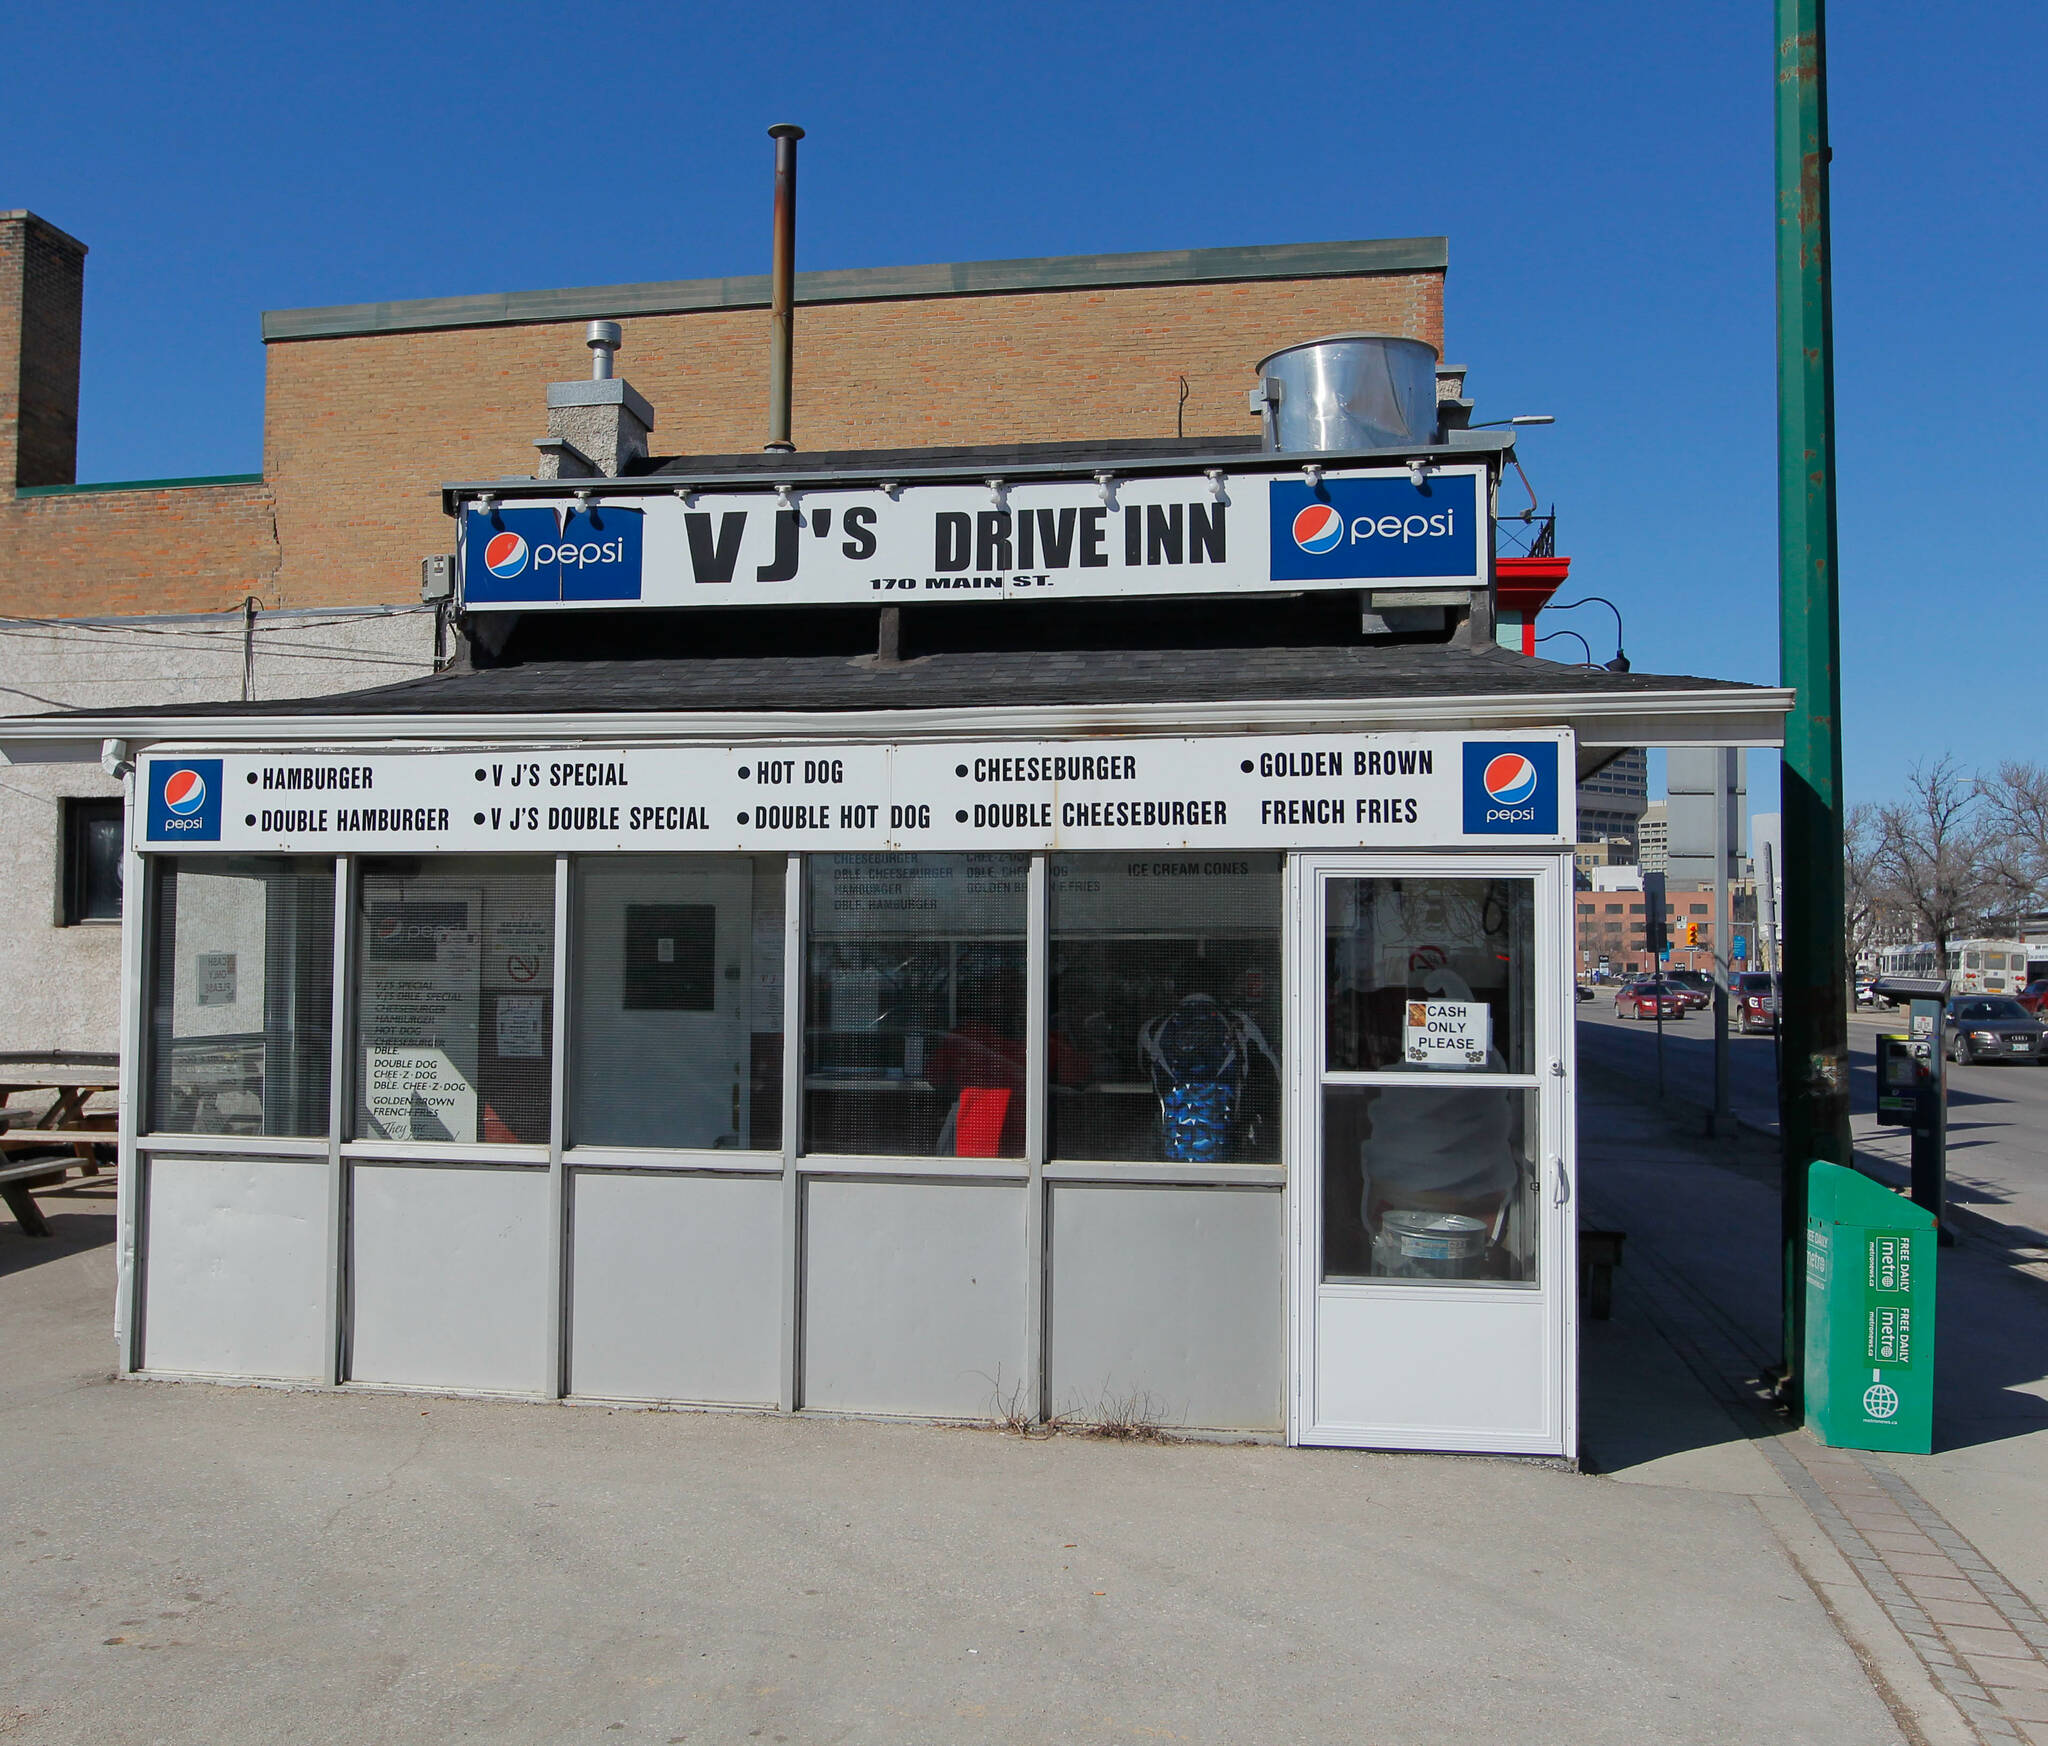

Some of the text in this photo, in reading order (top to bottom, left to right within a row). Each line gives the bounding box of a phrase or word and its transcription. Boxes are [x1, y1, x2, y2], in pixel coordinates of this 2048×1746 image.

[935, 505, 1108, 571] DRIVE
[1125, 502, 1226, 566] INN
[1351, 509, 1453, 544] pepsi
[534, 536, 623, 571] pepsi
[870, 575, 1053, 589] 170 MAIN ST.
[550, 763, 628, 786] SPECIAL
[758, 760, 842, 784] HOT DOG
[975, 756, 1135, 782] CHEESEBURGER
[1261, 751, 1432, 777] GOLDEN BROWN
[263, 767, 372, 789] HAMBURGER
[262, 808, 448, 832] DOUBLE HAMBURGER
[549, 807, 619, 830] DOUBLE
[630, 807, 709, 830] SPECIAL
[756, 805, 930, 829] DOUBLE HOT DOG
[975, 801, 1226, 827] DOUBLE CHEESEBURGER
[1262, 799, 1417, 824] FRENCH FRIES
[1487, 806, 1534, 823] pepsi
[165, 816, 203, 831] pepsi
[1128, 862, 1249, 877] ICE CREAM CONES
[1427, 1006, 1466, 1017] CASH
[1427, 1022, 1466, 1033] ONLY
[1419, 1037, 1475, 1050] PLEASE
[374, 1060, 438, 1069] DOUBLE DOG
[373, 1082, 400, 1091] DBLE.
[373, 1097, 413, 1106] GOLDEN
[373, 1108, 412, 1117] FRENCH
[1882, 1241, 1895, 1288] metro
[1901, 1238, 1910, 1292] FREE DAILY
[1881, 1312, 1895, 1358] metro
[1900, 1308, 1910, 1363] FREE DAILY
